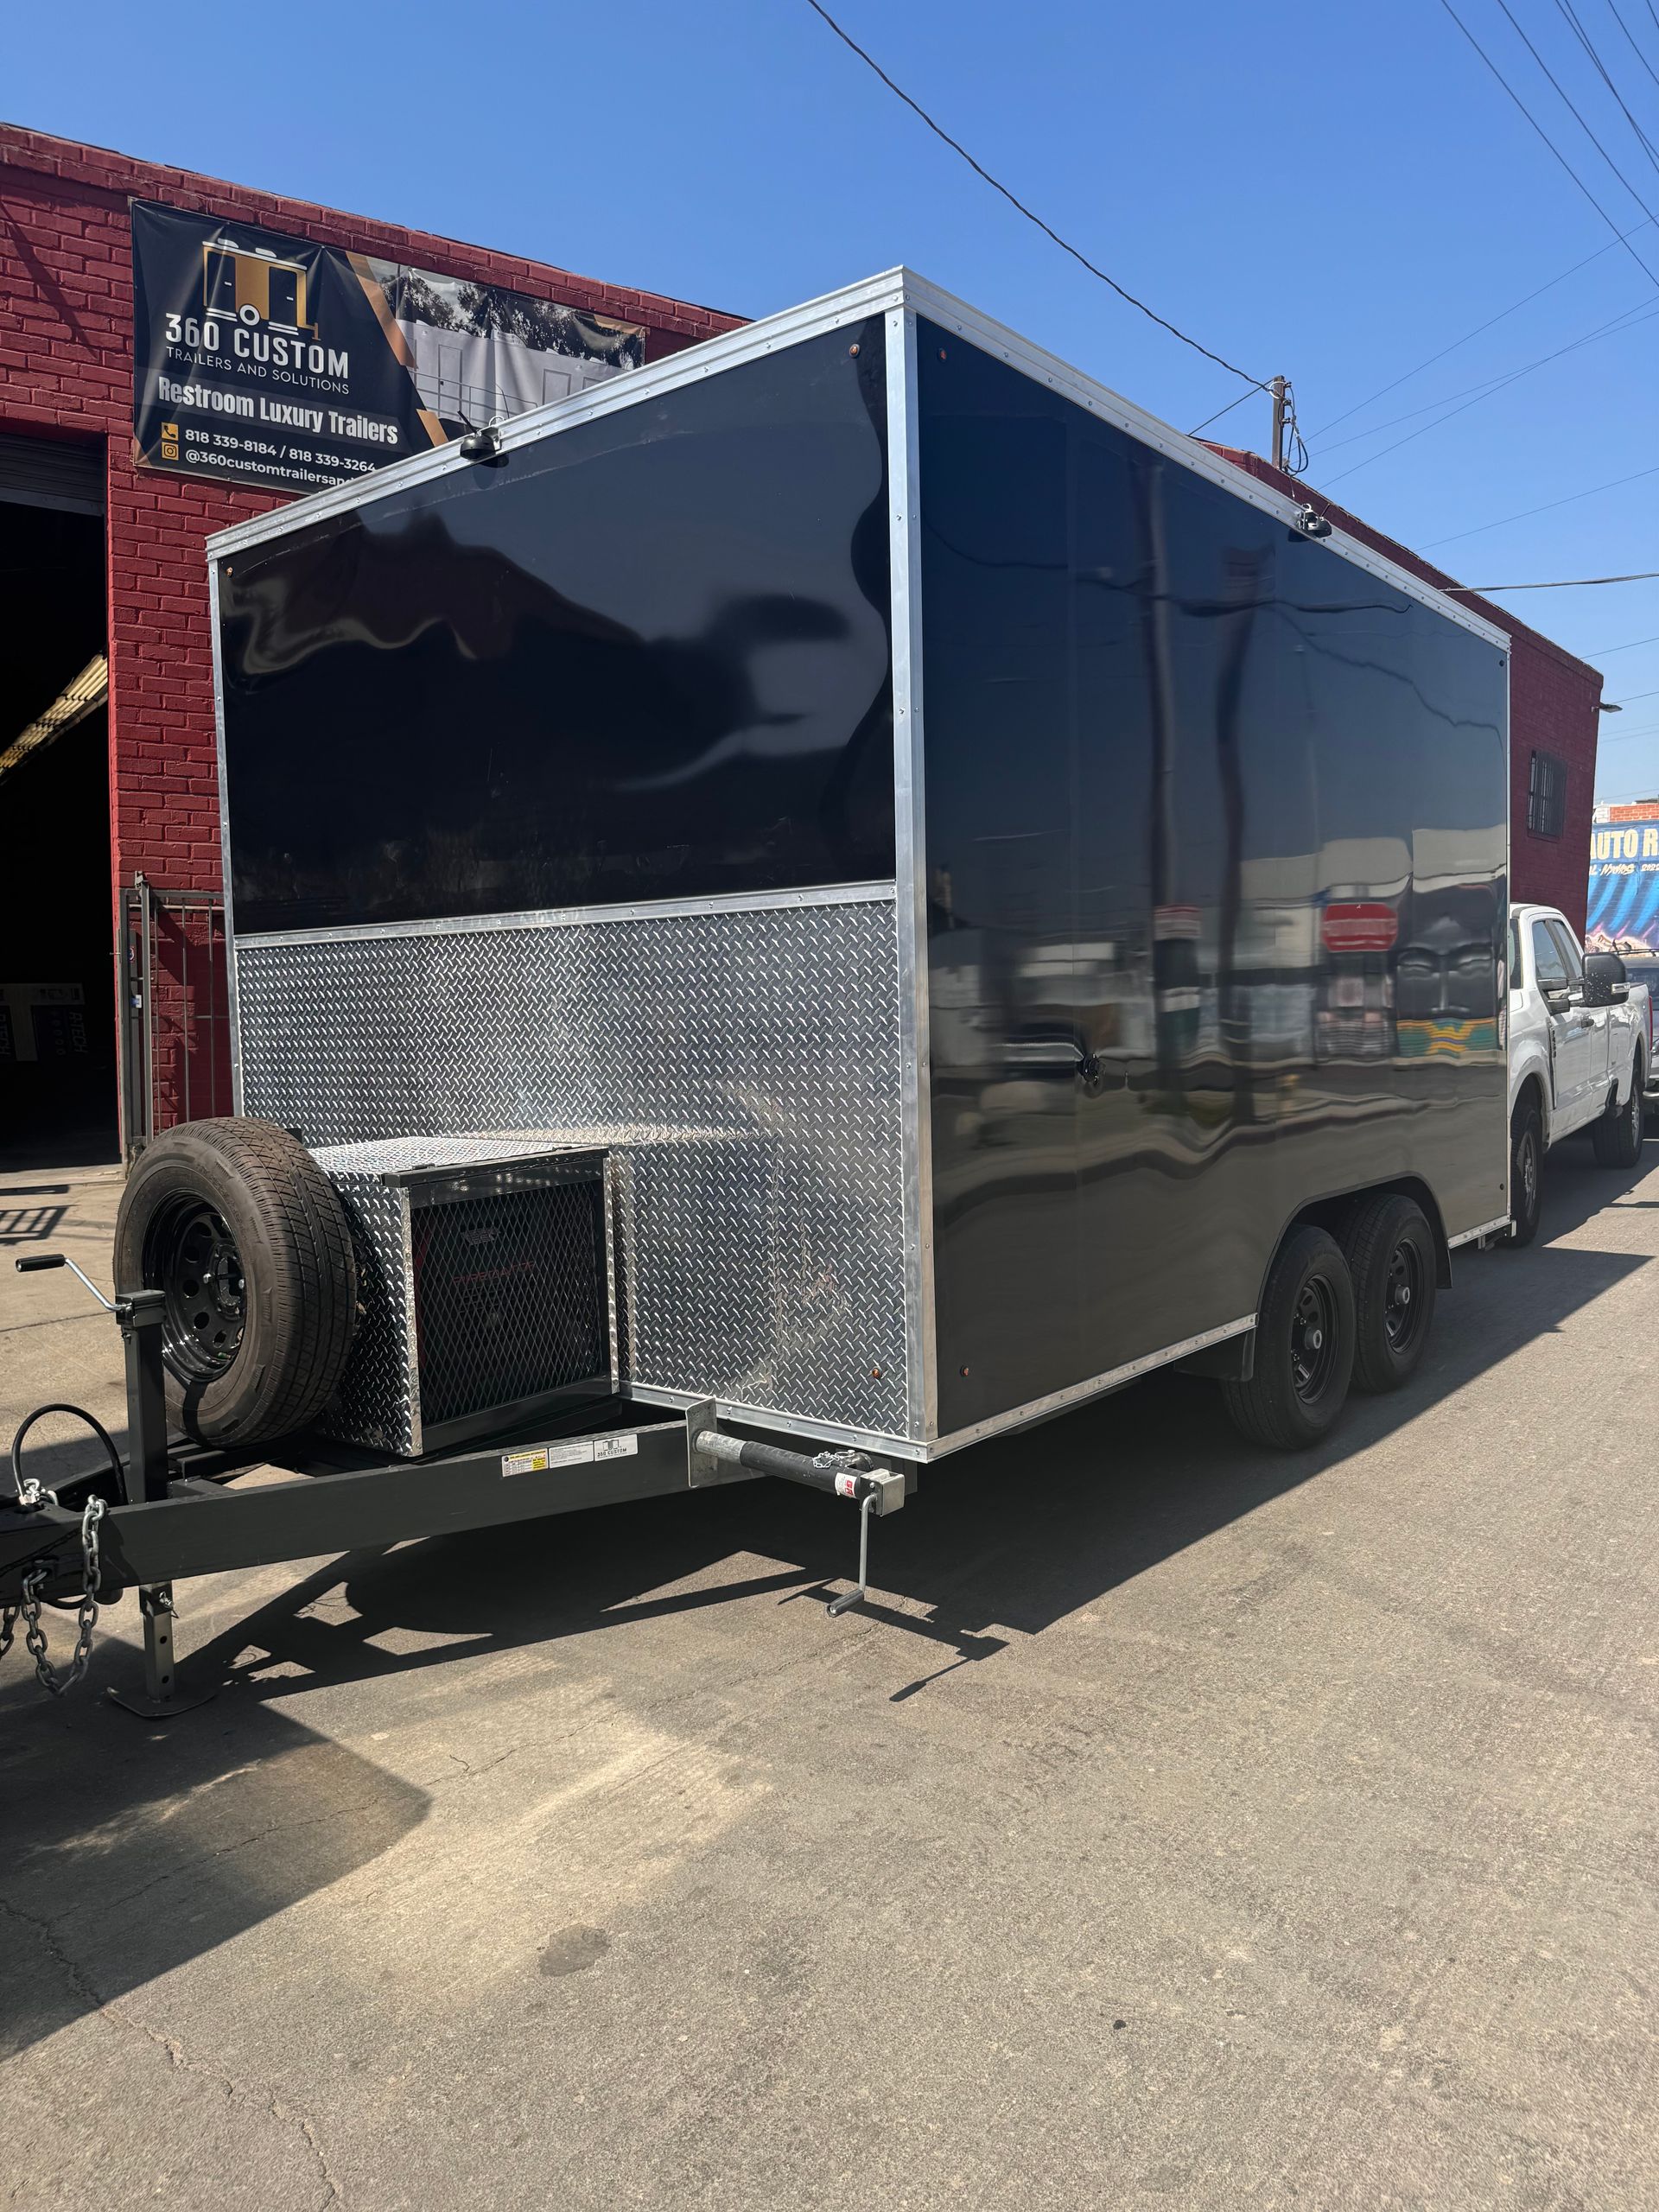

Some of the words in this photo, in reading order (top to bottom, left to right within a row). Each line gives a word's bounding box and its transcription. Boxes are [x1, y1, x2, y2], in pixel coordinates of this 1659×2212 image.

[165, 312, 219, 352] 360
[233, 327, 349, 379] CUSTOM
[165, 346, 232, 372] TRAILERS
[237, 362, 267, 378] AND
[271, 369, 350, 396] SOLUTIONS
[158, 376, 255, 418] Restroom
[259, 397, 324, 434] Luxury
[328, 410, 398, 445] Trailers
[184, 429, 210, 445] 818
[213, 434, 277, 459] 339-8184
[279, 445, 287, 460] /
[289, 447, 313, 463] 818
[315, 452, 377, 473] 339-3264
[184, 448, 354, 487] @360customtrailersan
